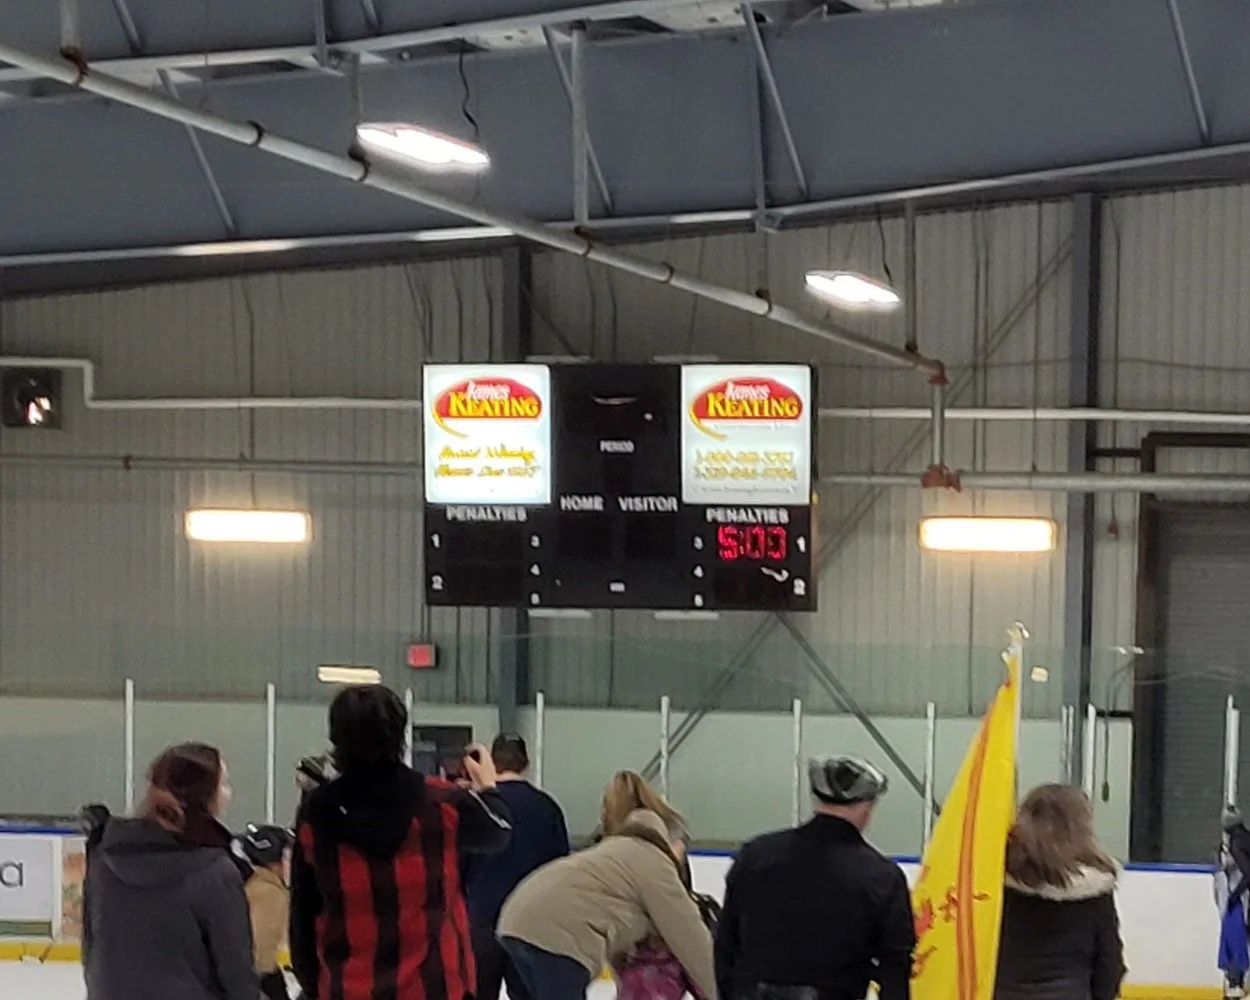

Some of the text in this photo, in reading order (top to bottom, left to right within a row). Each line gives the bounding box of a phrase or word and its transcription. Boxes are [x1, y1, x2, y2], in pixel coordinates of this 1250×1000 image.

[449, 391, 539, 417] KEATING
[707, 391, 799, 417] KEATING
[560, 495, 604, 511] HOME
[618, 496, 679, 512] VISITOR
[446, 505, 528, 522] PENALTIES
[706, 508, 790, 524] PENALTIES
[431, 533, 440, 548] 1
[796, 536, 806, 553] 1
[432, 575, 443, 590] 2
